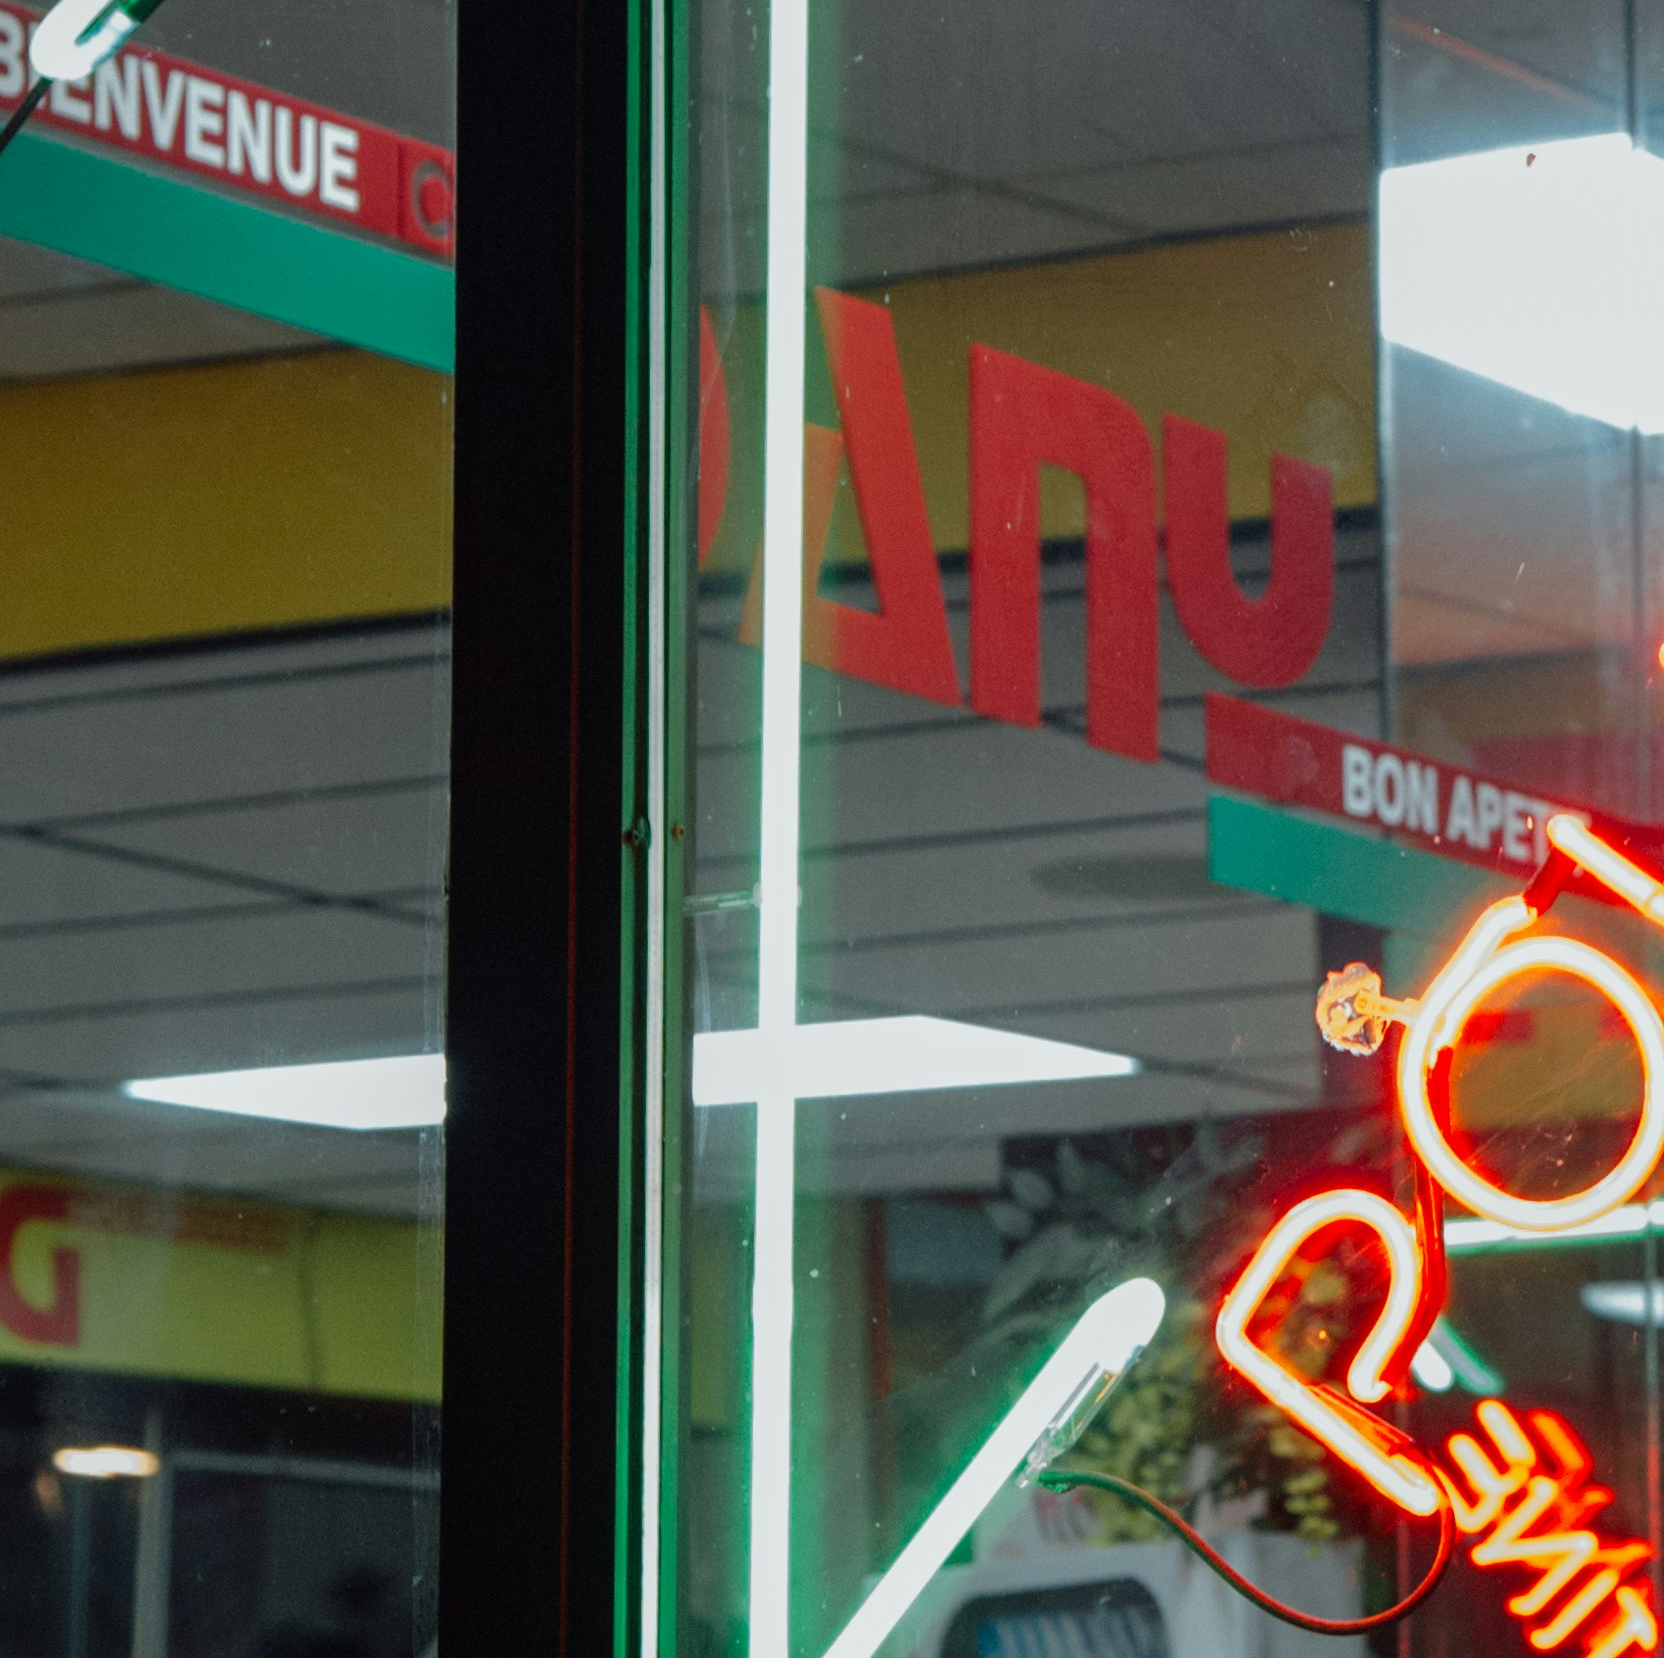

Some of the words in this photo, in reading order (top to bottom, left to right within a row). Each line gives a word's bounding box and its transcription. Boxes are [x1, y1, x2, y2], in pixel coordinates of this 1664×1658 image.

[0, 11, 362, 215] BENVENUE
[1340, 743, 1440, 838] BON
[1445, 773, 1595, 879] APET
